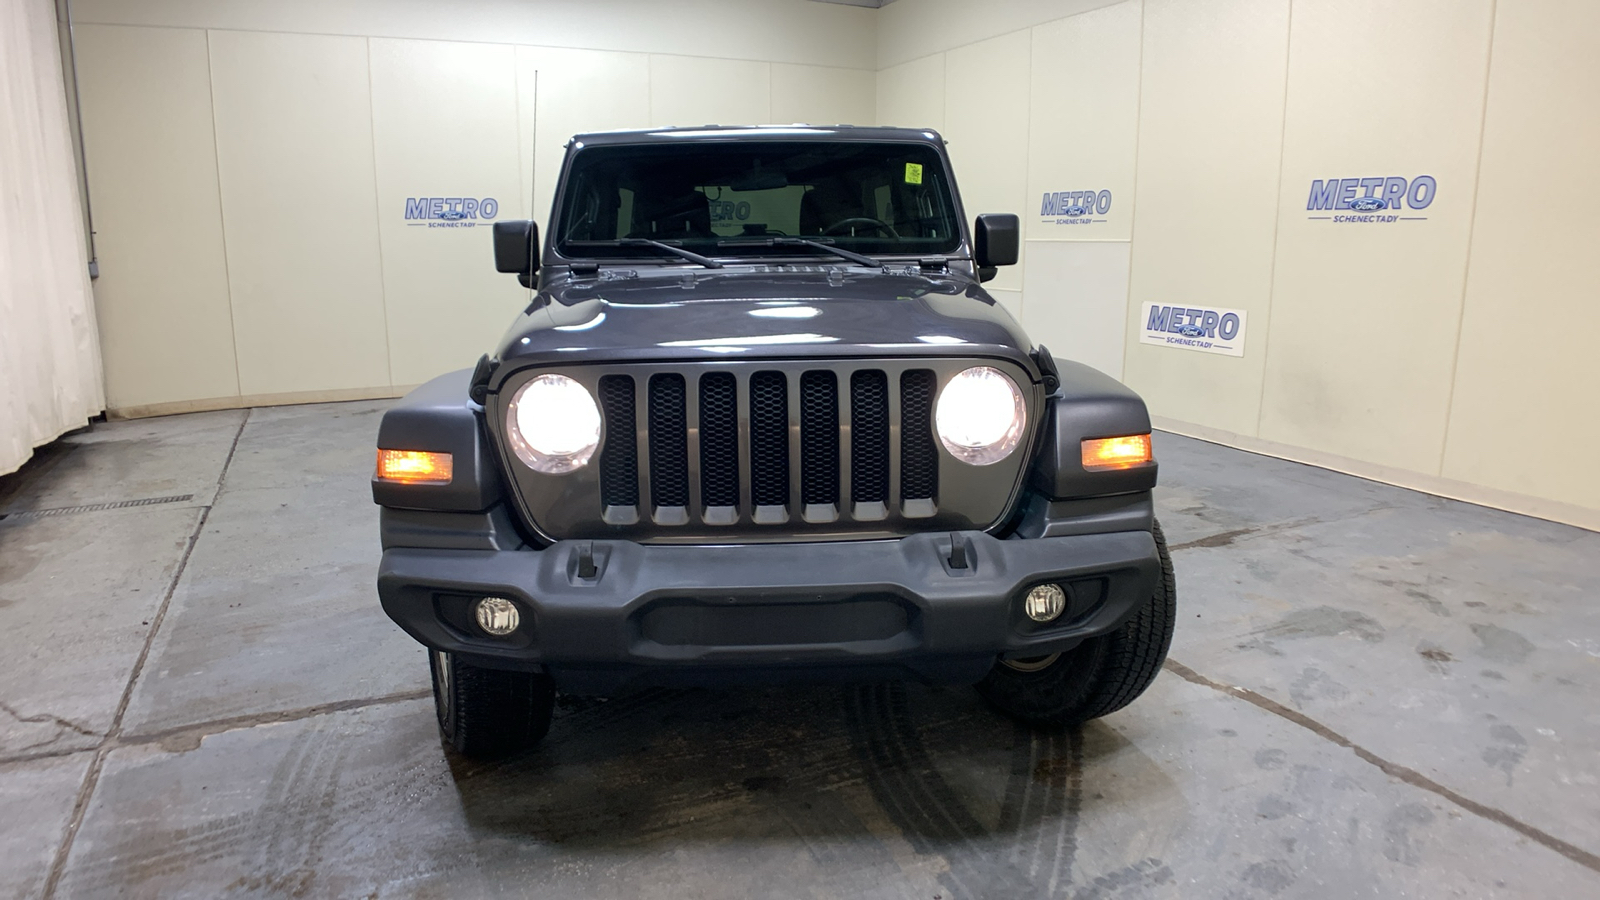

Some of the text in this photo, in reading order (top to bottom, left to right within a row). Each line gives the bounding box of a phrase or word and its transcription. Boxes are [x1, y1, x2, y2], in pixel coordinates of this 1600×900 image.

[1040, 189, 1112, 216] METRO
[1306, 175, 1437, 210] METRO
[404, 197, 499, 220] METRO
[708, 200, 751, 221] TRO
[1333, 215, 1399, 223] SCHENECTADY
[1146, 305, 1240, 341] METRO
[1166, 336, 1213, 349] SCHENECTADY
